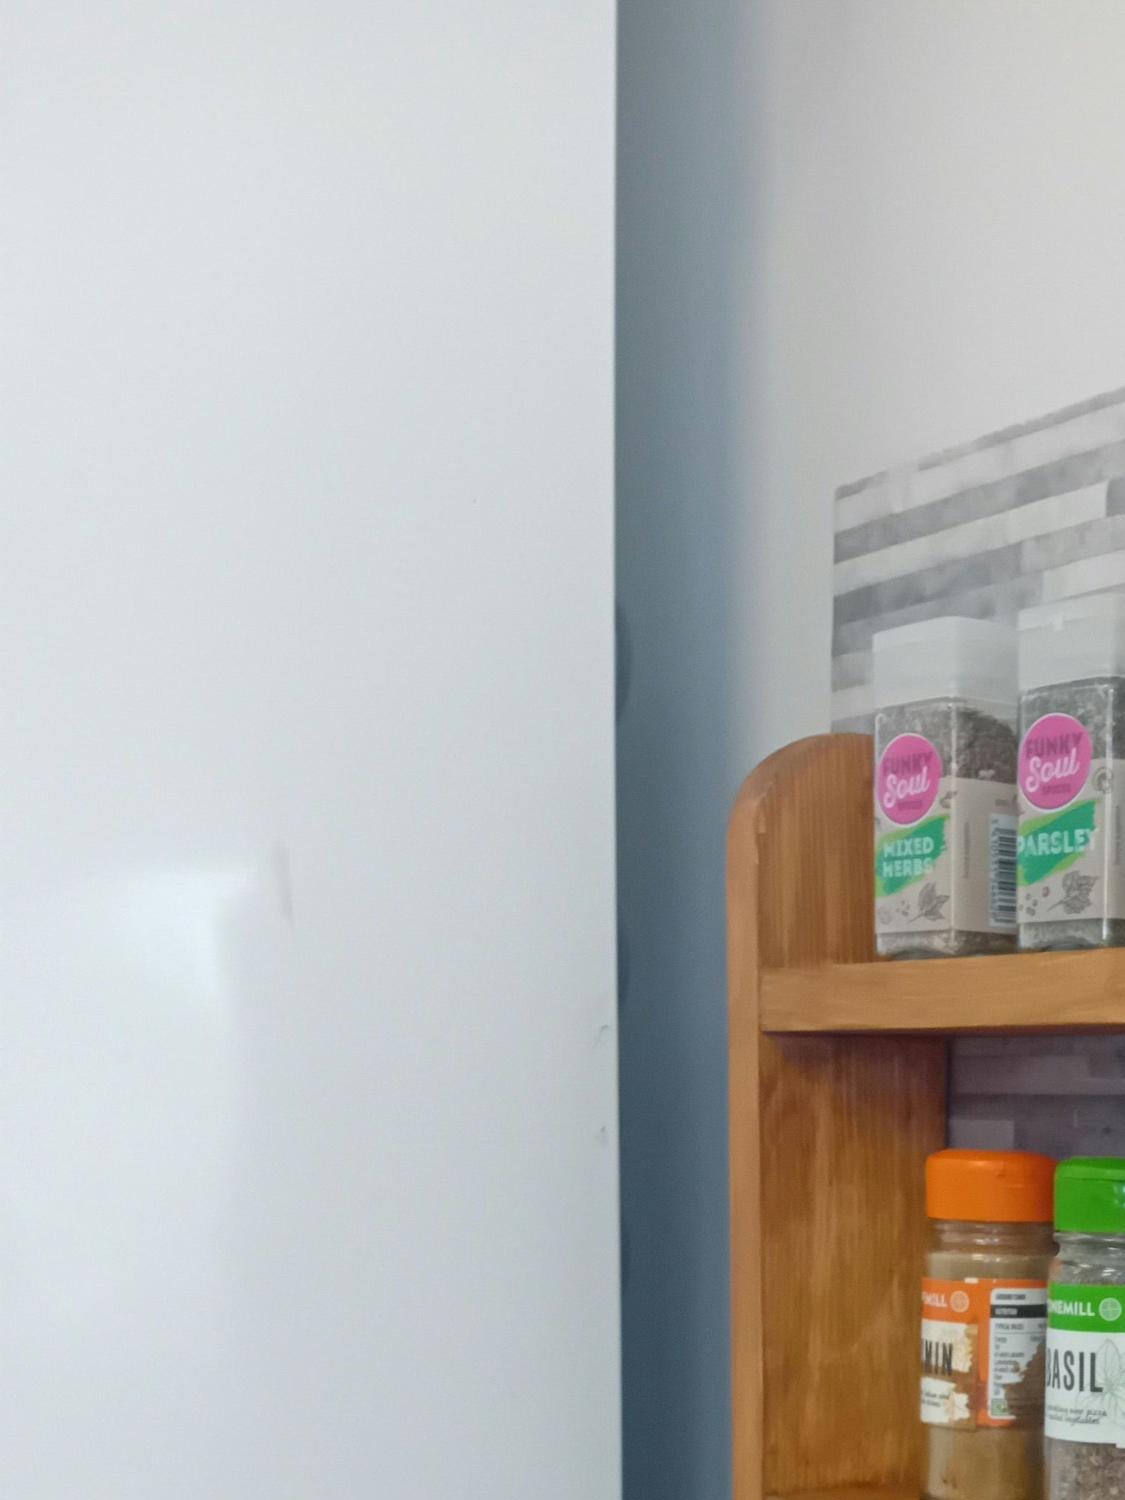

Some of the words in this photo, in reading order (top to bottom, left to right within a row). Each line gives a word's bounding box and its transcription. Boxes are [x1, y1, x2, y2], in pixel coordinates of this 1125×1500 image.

[1026, 731, 1084, 758] FUNKY
[1025, 747, 1080, 793] Soul
[883, 766, 931, 808] Soul
[883, 836, 935, 858] MIXED
[882, 857, 934, 878] HERBS
[922, 1339, 953, 1376] MIN
